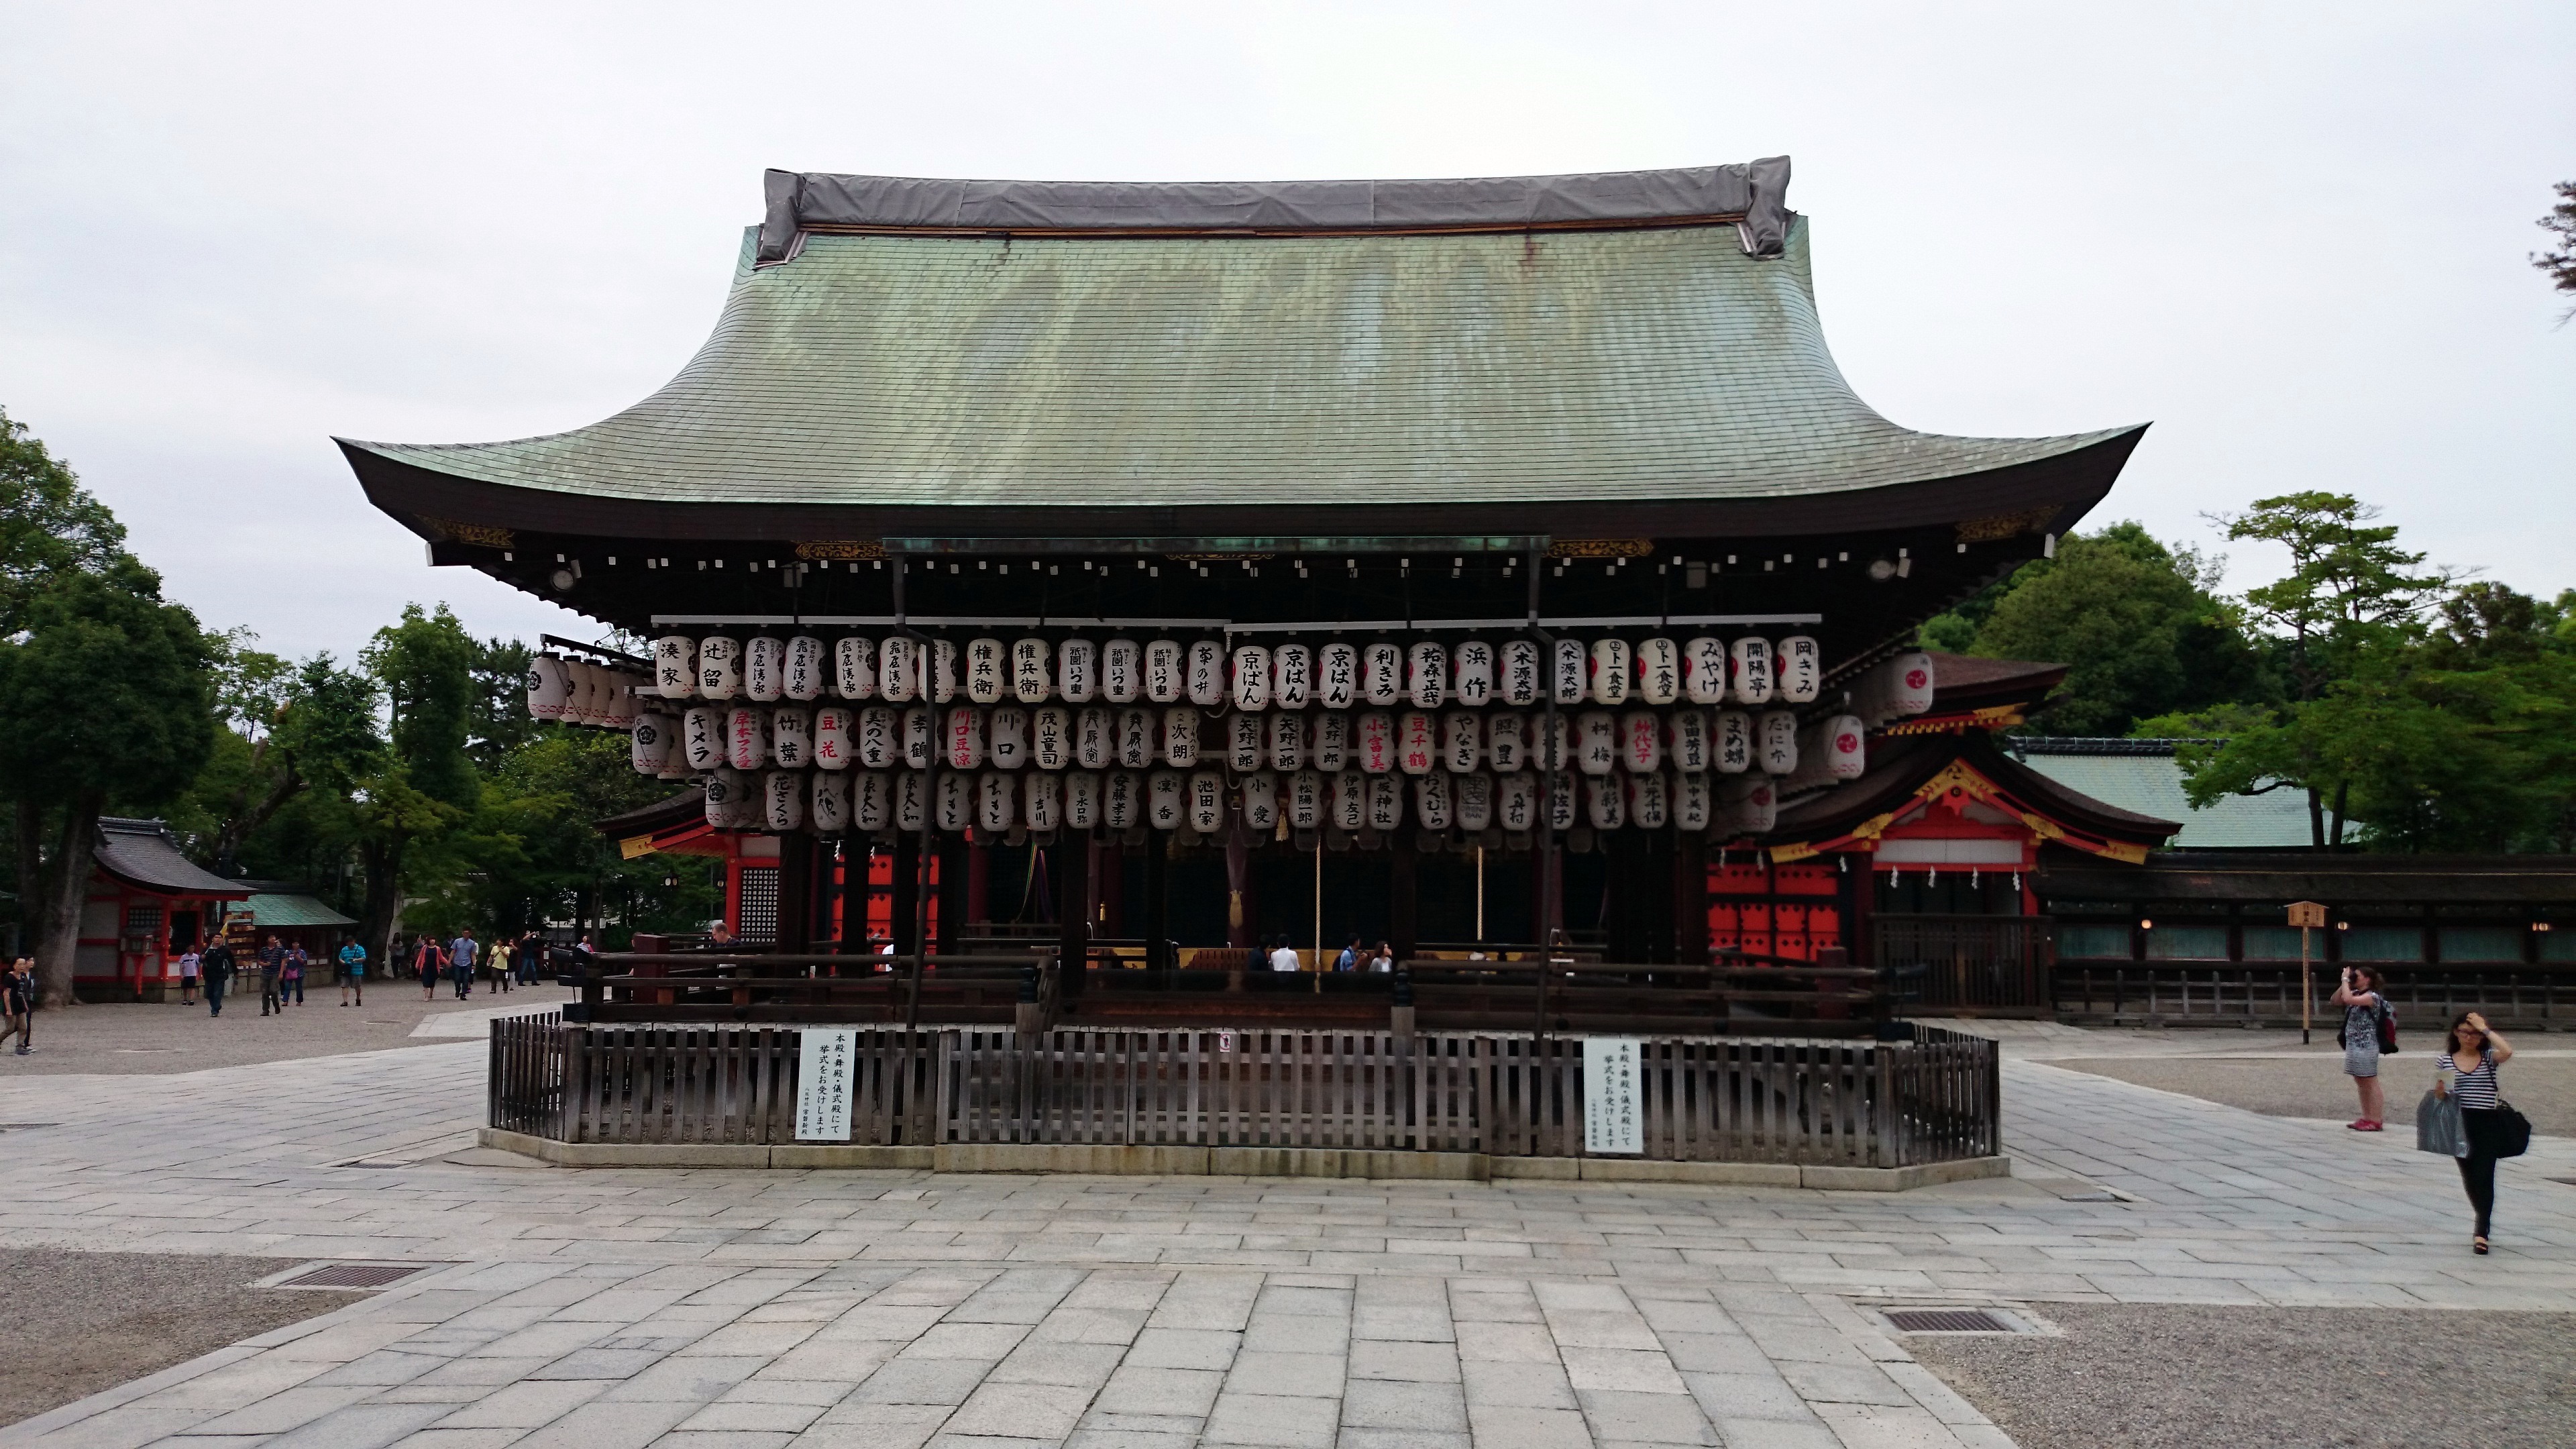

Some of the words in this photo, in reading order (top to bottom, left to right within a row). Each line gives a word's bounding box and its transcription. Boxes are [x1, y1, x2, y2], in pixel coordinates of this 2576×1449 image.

[660, 642, 682, 686] 湊家
[703, 643, 725, 687] 辻留
[973, 644, 994, 696] 権兵衛
[1018, 643, 1040, 696] 権兵衛
[1069, 647, 1082, 694] 祇園いづ重
[1112, 648, 1124, 696] 祇園いづ重
[1154, 648, 1167, 696] 祇園いづ重
[1194, 647, 1213, 696] 菊の井
[1242, 651, 1263, 704] 京ばん
[1285, 648, 1306, 703] 京ばん
[1329, 648, 1350, 703] 京ばん
[1374, 649, 1395, 698] 利きみ
[1420, 647, 1442, 704] 祐森正哉
[1464, 647, 1487, 698] 浜作
[1511, 643, 1533, 702] 八木源太郎
[1558, 642, 1578, 700] 八木源太郎
[1701, 642, 1719, 694] みやけ
[690, 714, 710, 763] キメラ
[777, 715, 798, 762] 竹葉
[819, 716, 838, 758] 豆花
[865, 710, 884, 763] 美の八重
[954, 710, 971, 766] 川口豆涼
[998, 713, 1015, 755] 川口
[1040, 712, 1058, 765] 茂山童司
[1171, 724, 1187, 759] 次朗
[1238, 718, 1255, 767] 矢野一郎
[1279, 717, 1296, 768] 矢野一郎
[1324, 716, 1341, 765] 矢野一郎
[1366, 718, 1384, 769] 小富美
[1409, 718, 1427, 767] 豆千鶴
[1456, 715, 1474, 765] やなぎ
[773, 775, 790, 826] 花さくら
[1112, 774, 1130, 825] 安藤孝子
[1197, 780, 1215, 826] 池田家
[1250, 778, 1271, 824] 小愛
[1297, 772, 1312, 824] 小松陽一郎
[816, 1044, 830, 1135] 挙式をお受けします
[831, 1033, 845, 1133] 本殿・舞殿・儀式殿にて
